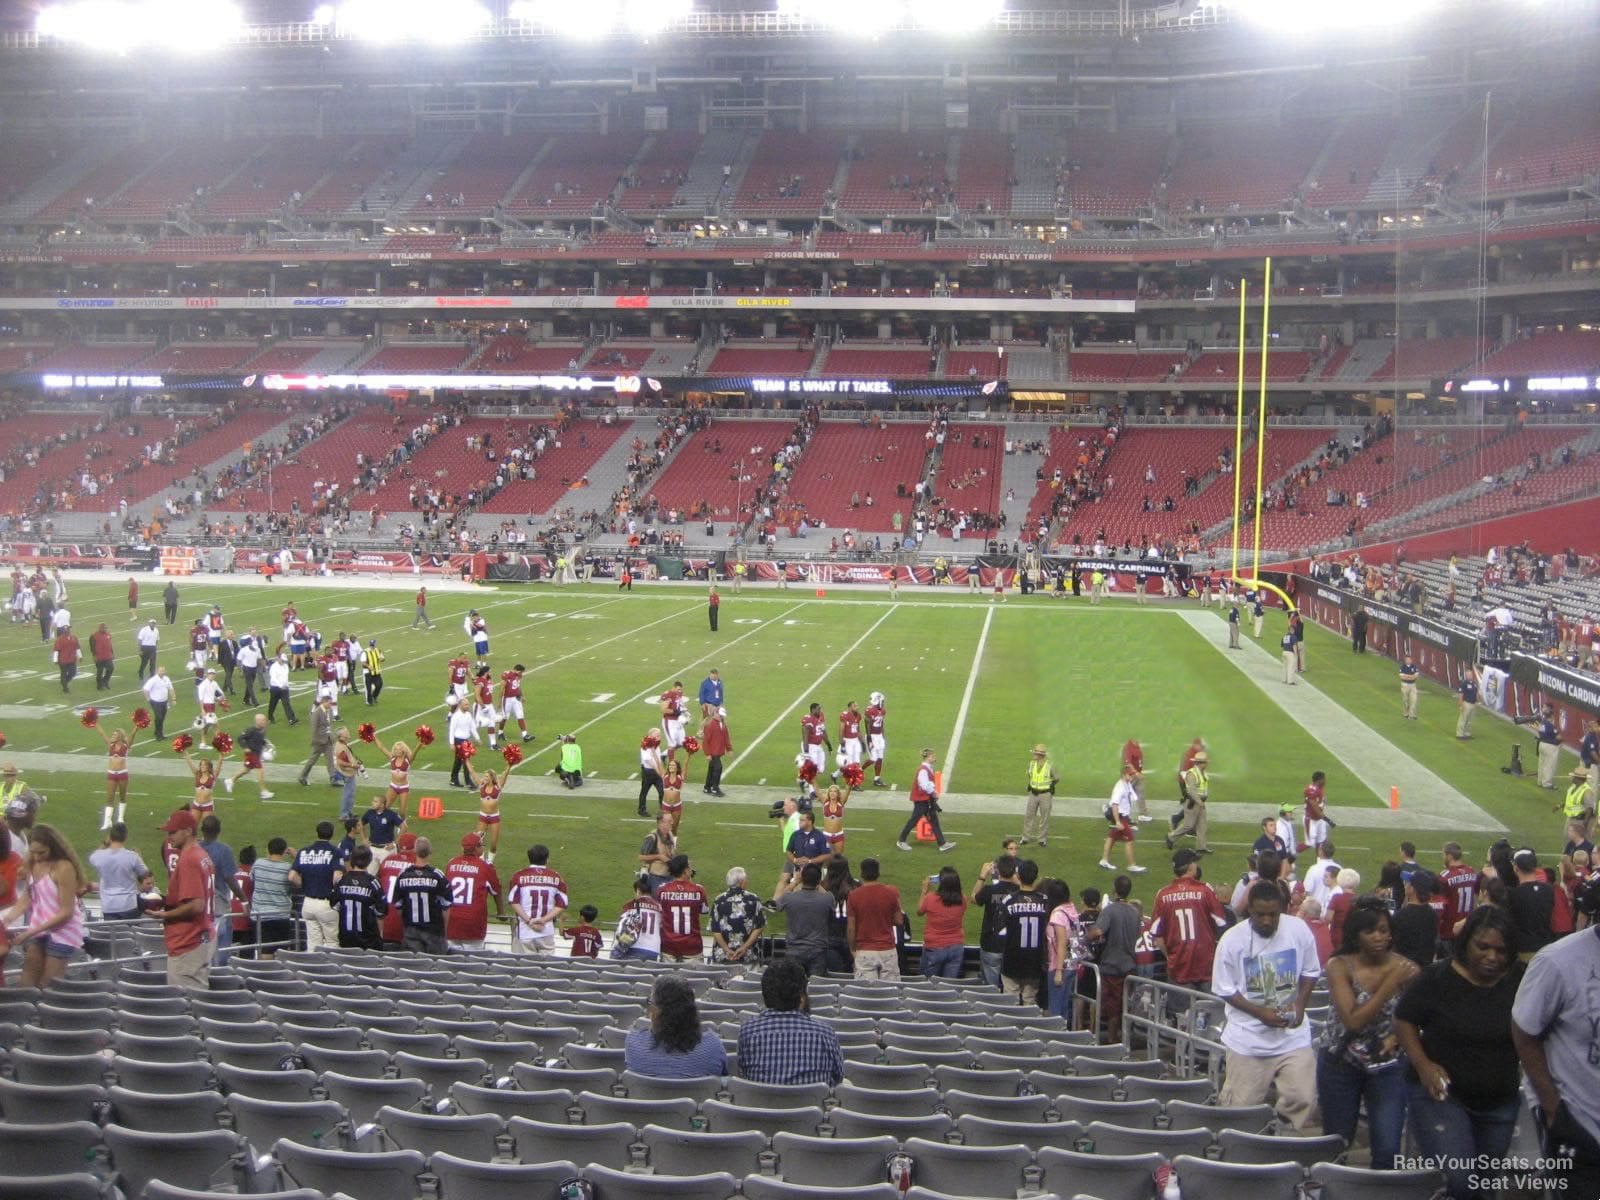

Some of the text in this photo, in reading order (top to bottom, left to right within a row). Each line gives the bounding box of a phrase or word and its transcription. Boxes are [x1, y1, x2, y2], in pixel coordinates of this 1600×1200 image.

[672, 298, 724, 306] GILA RIVER
[736, 298, 791, 306] GILA RIVER
[788, 380, 801, 392] IS
[802, 380, 838, 392] WHAT
[838, 380, 851, 392] IT
[1077, 561, 1167, 574] ARIZONA CARDINALS
[1537, 670, 1568, 694] ARIZONA
[422, 799, 436, 815] 10
[299, 854, 334, 865] SECURITY
[449, 864, 480, 874] PETERSON
[399, 877, 438, 888] FITZGERALD
[519, 875, 560, 886] FITZGERALD
[451, 876, 475, 905] 21
[660, 891, 701, 901] FITZGERALD
[1162, 891, 1203, 903] FITZGERALD
[529, 889, 550, 919] 11
[1457, 886, 1472, 913] 11
[409, 891, 431, 923] 11
[1007, 903, 1046, 914] FITZGERAL
[344, 899, 363, 932] 11
[671, 906, 692, 935] 11
[641, 911, 656, 935] 11
[1175, 908, 1196, 941] 11
[1019, 916, 1040, 948] 11
